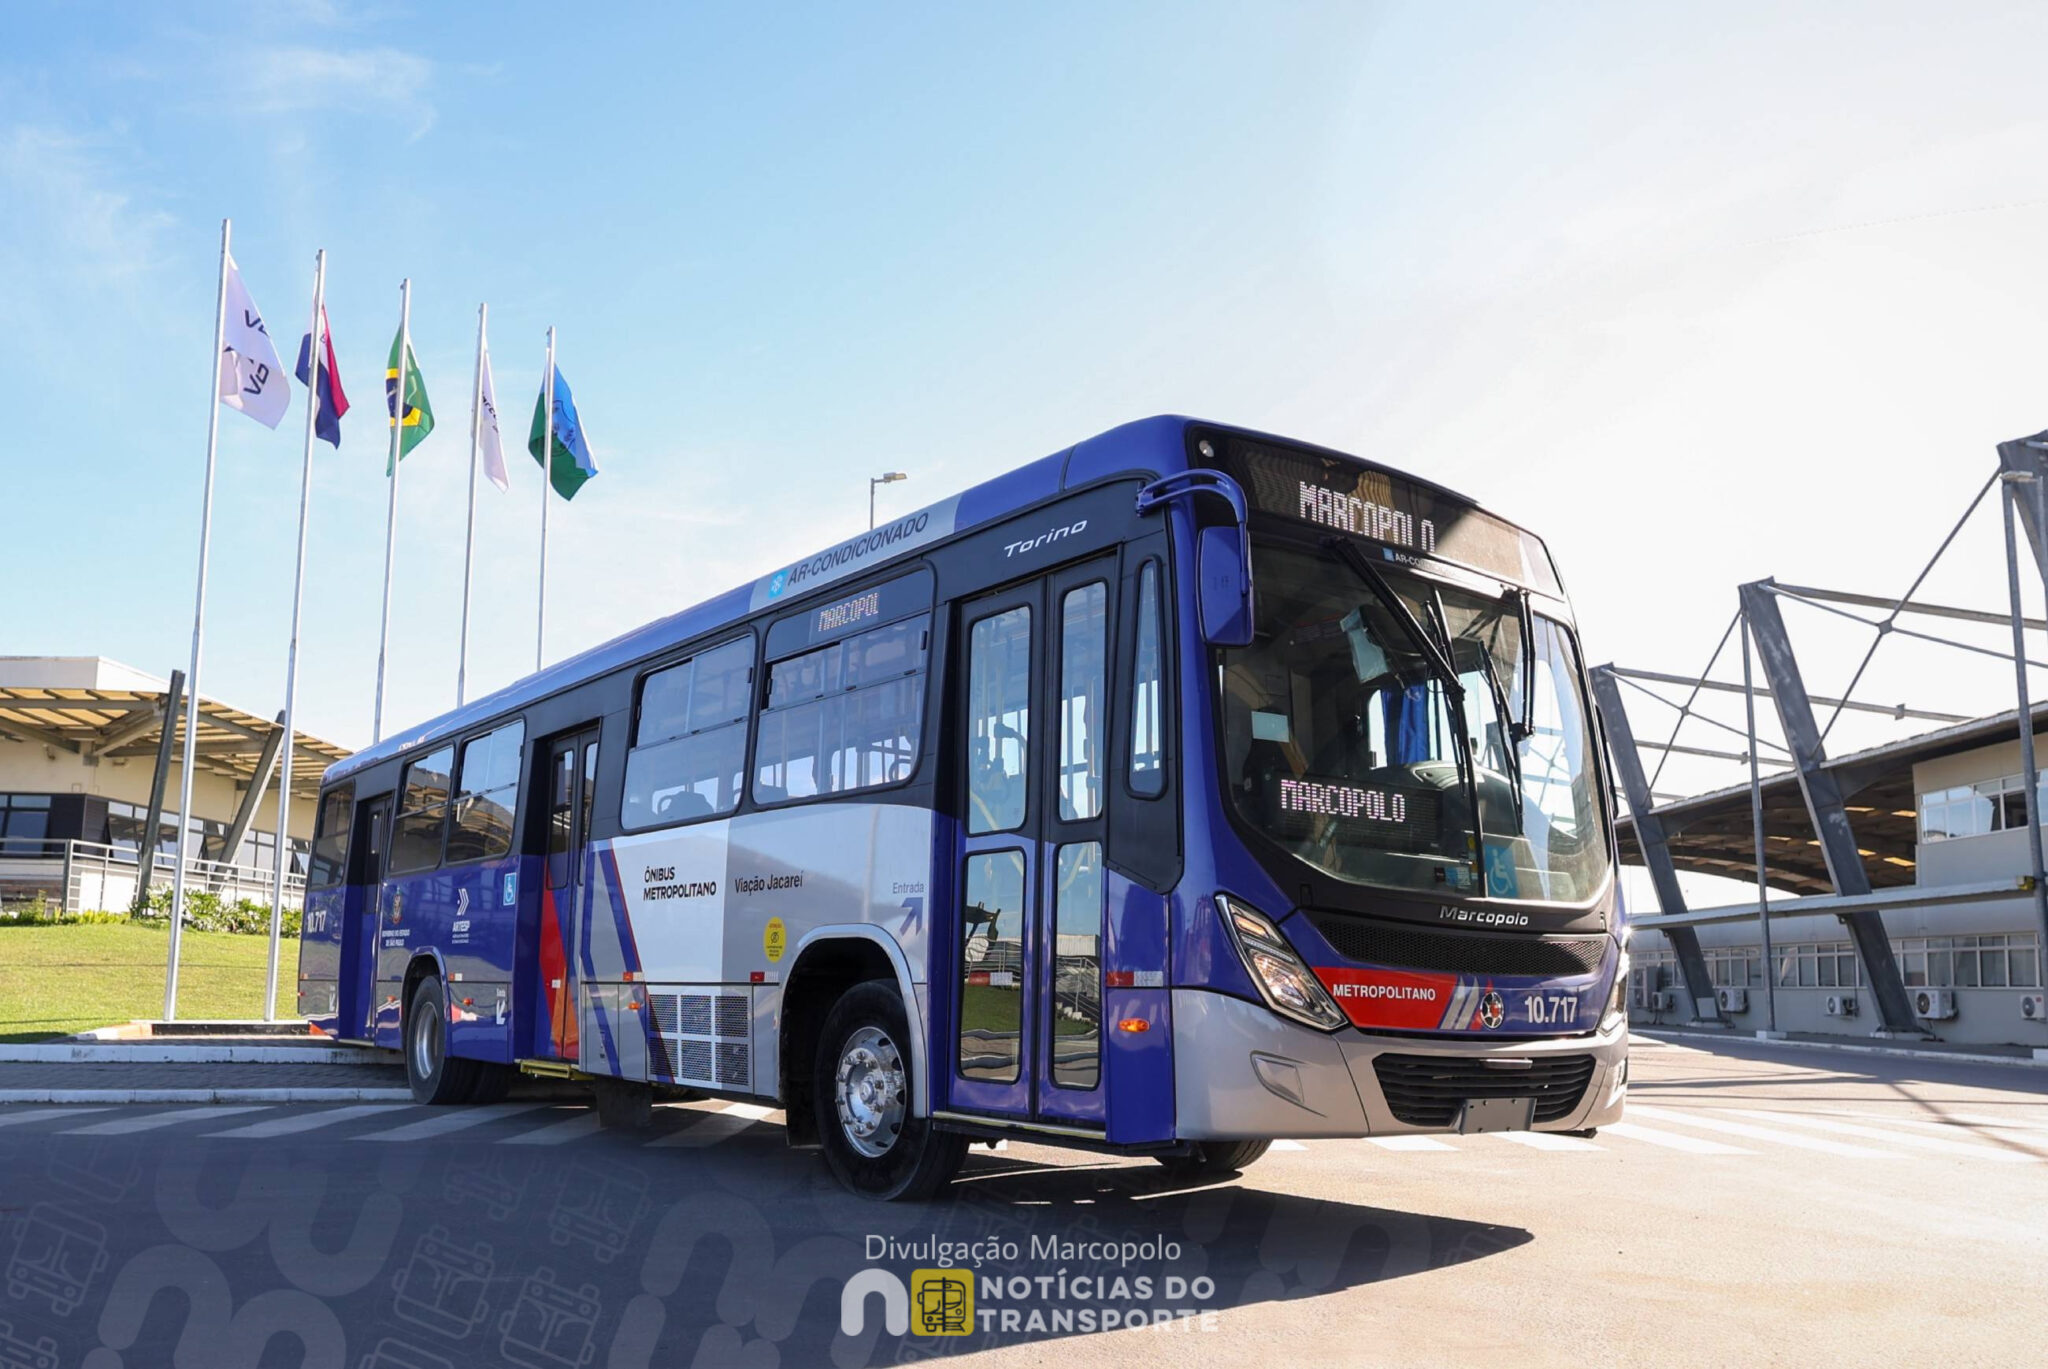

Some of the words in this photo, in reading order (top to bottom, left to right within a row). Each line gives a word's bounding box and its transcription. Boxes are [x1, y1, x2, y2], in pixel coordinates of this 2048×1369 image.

[787, 512, 929, 586] AR-CONDICIONADO
[1004, 519, 1088, 558] Torino
[818, 592, 879, 632] MARCOPOL
[1280, 778, 1406, 823] MARCOPOLO
[644, 865, 675, 883] ÔNIBUS
[734, 876, 766, 897] Viação
[767, 870, 804, 889] Jacareí
[892, 881, 925, 894] Entrada
[643, 881, 717, 901] METROPOLITANO
[1439, 905, 1529, 926] Marcopolo
[1333, 983, 1436, 1001] METROPOLITANO
[1524, 996, 1578, 1023] 10.717
